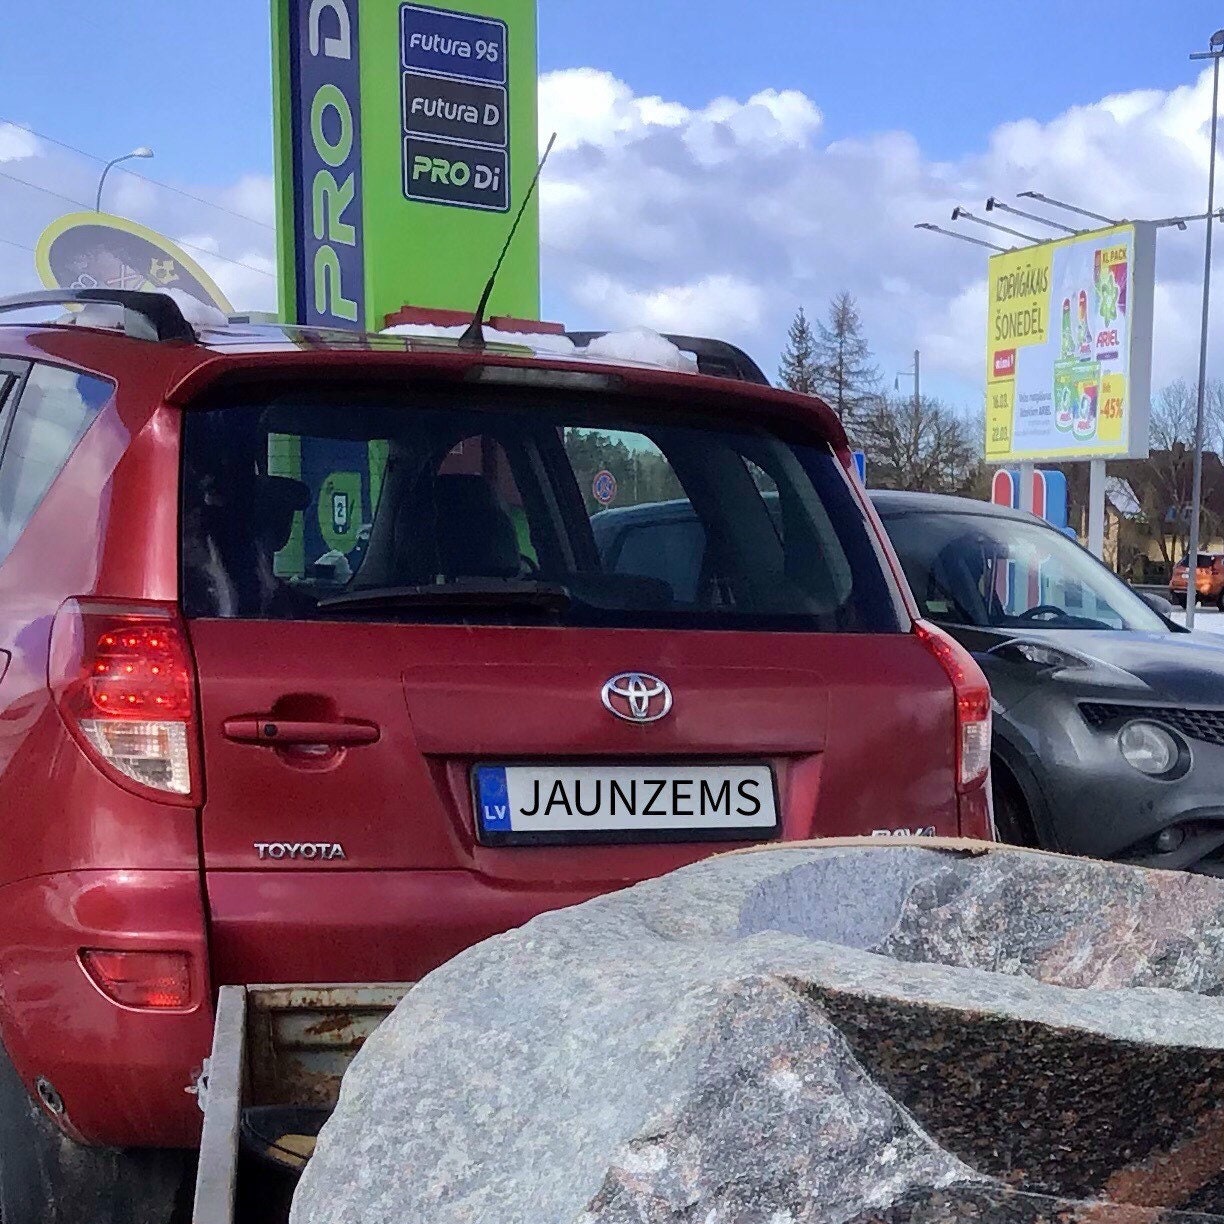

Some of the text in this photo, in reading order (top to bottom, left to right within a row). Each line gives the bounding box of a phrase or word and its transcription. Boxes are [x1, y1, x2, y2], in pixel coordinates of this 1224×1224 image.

[410, 33, 498, 62] Futura 95
[411, 97, 500, 126] Futura D
[412, 155, 500, 191] PRO Di
[309, 84, 358, 323] PRO
[519, 778, 761, 817] JAUNZEMS
[485, 806, 506, 821] LV
[254, 842, 346, 860] TOYOTA
